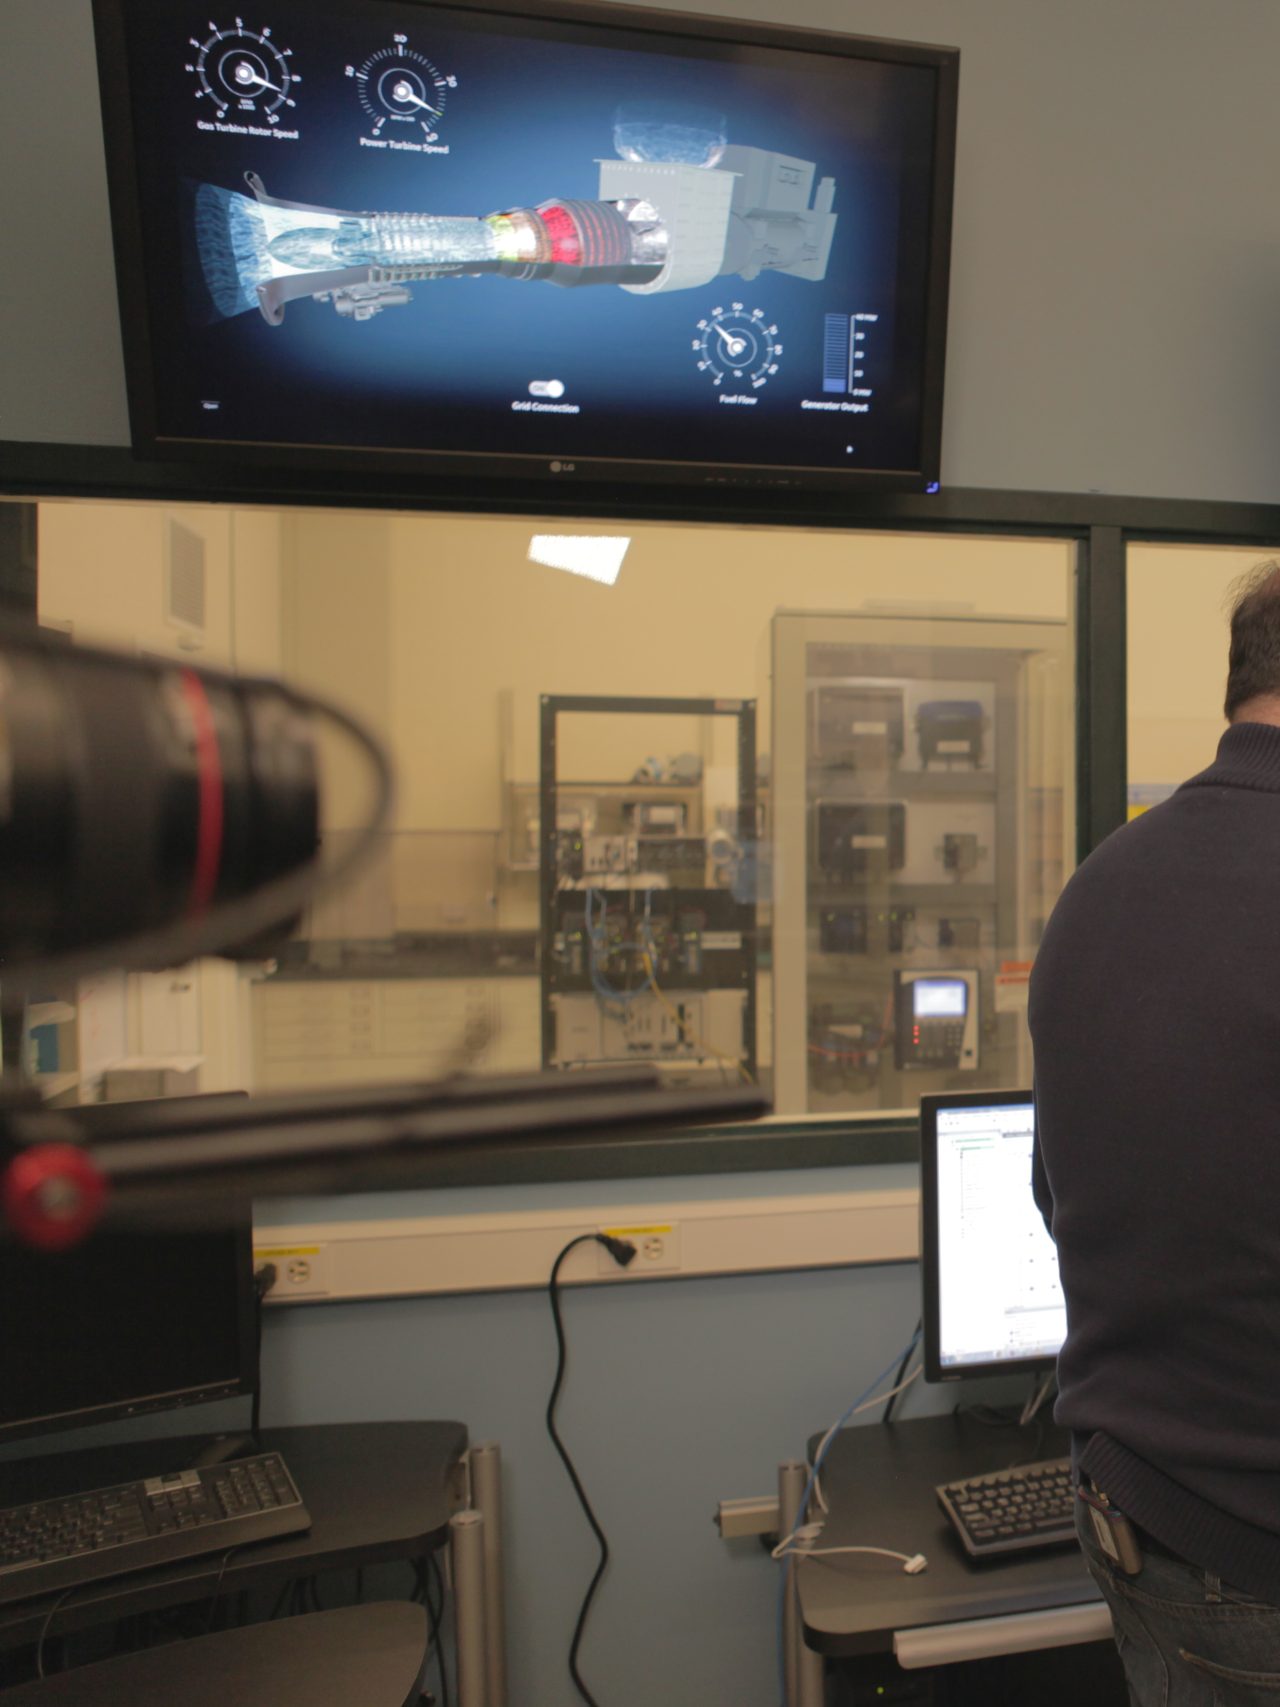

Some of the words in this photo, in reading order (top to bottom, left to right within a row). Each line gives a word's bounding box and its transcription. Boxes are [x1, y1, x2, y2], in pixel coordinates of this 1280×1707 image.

[235, 16, 243, 27] 5
[262, 27, 271, 37] 6
[393, 33, 408, 43] 20
[344, 64, 355, 77] 10
[446, 75, 458, 88] 30
[267, 114, 279, 124] 10
[197, 120, 215, 130] Gas
[215, 121, 248, 134] Turbine
[248, 126, 272, 136] Rotor
[272, 128, 299, 139] Speed
[360, 137, 388, 148] Power
[388, 140, 422, 152] Turbine
[422, 143, 450, 154] Speed
[719, 394, 738, 405] Fuel
[738, 395, 758, 405] Flow
[511, 400, 531, 412] Grid
[531, 402, 580, 414] Connection
[801, 399, 841, 411] Generator
[841, 401, 869, 413] Output
[562, 463, 575, 472] LG
